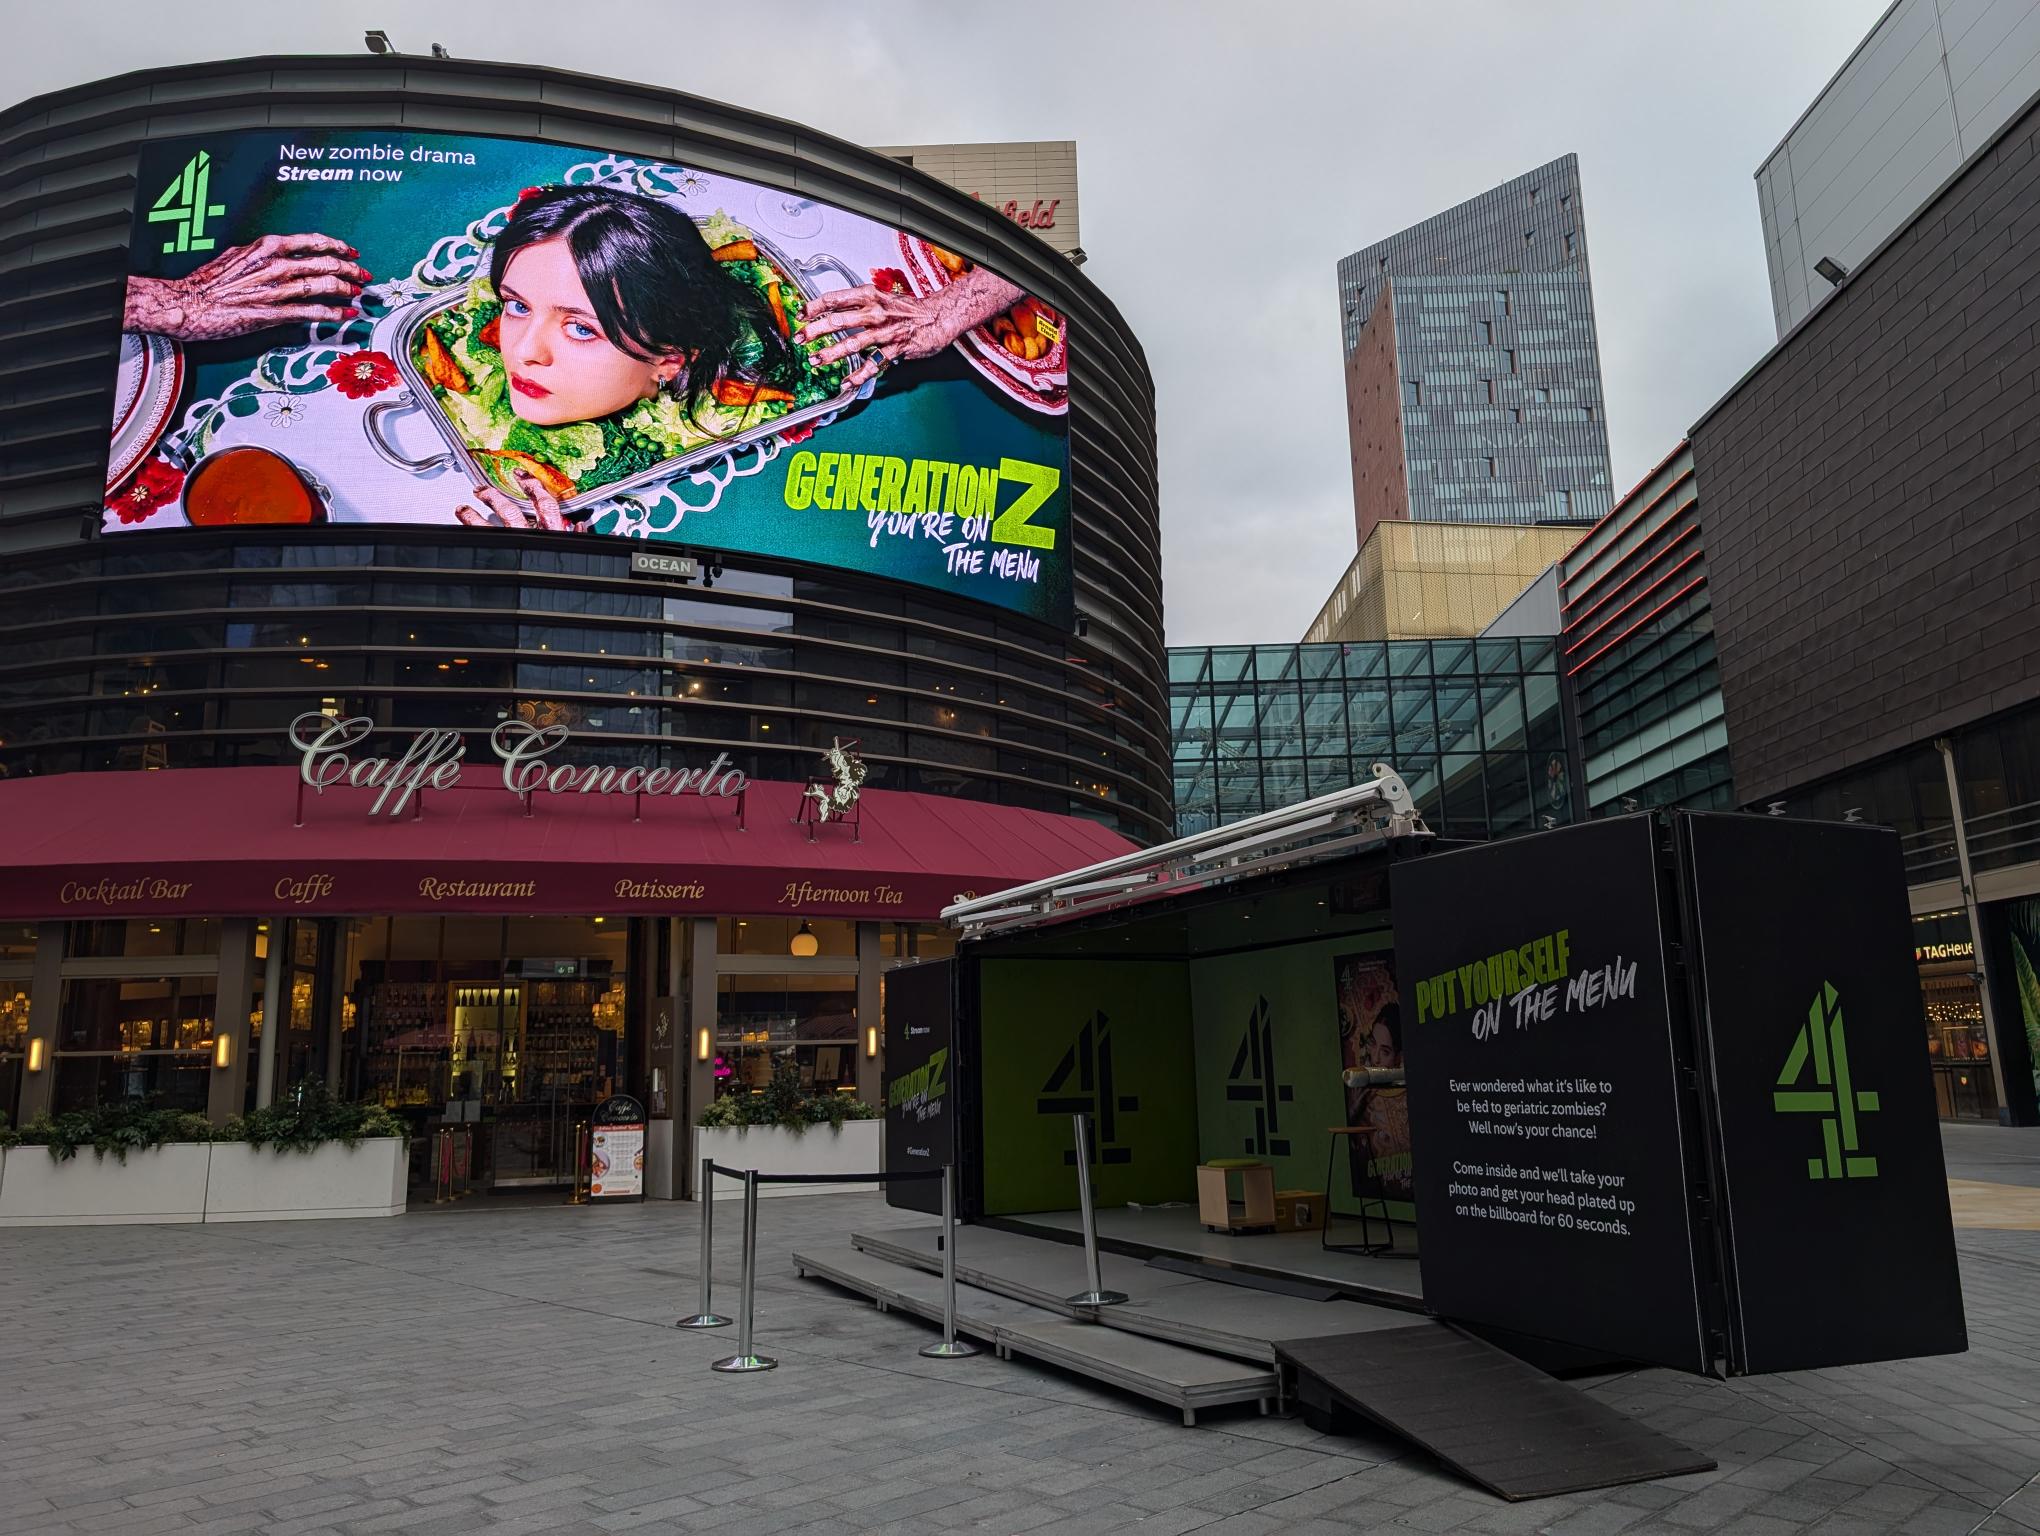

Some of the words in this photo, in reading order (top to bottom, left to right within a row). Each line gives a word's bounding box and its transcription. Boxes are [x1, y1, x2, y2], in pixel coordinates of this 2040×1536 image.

[279, 144, 324, 160] New
[328, 144, 405, 161] zombie
[409, 146, 476, 165] drama
[276, 165, 354, 182] Stream
[358, 168, 402, 182] now
[784, 451, 999, 521] GENERATION
[992, 457, 1061, 550] Z
[867, 509, 955, 548] YOU'RE
[961, 511, 991, 543] ON
[637, 556, 691, 573] OCEAN
[942, 542, 985, 577] THE
[989, 549, 1040, 584] MENU
[491, 720, 751, 801] Concerto
[60, 877, 150, 906] Cocktail
[149, 878, 193, 900] Bar
[419, 876, 536, 901] Restaurant
[614, 878, 705, 900] Patisserie
[778, 880, 870, 907] Afternoon
[874, 883, 904, 905] Tea
[1923, 944, 1947, 960] TAG
[1946, 942, 1974, 957] Heue
[1415, 970, 1457, 1024] PUT
[1457, 929, 1570, 1010] YOURSELF
[1471, 994, 1502, 1042] ON
[1509, 983, 1559, 1031] THE
[1565, 955, 1638, 1014] MENU
[928, 1047, 948, 1100] Z
[1449, 1079, 1470, 1092] Ever
[1472, 1079, 1525, 1093] wondered
[1526, 1079, 1554, 1093] what
[1556, 1079, 1573, 1093] it's
[1575, 1079, 1597, 1093] like
[1598, 1080, 1612, 1094] to
[1457, 1100, 1470, 1112] be
[1471, 1100, 1489, 1113] fed
[1490, 1101, 1502, 1114] to
[1504, 1101, 1550, 1117] geriatric
[1551, 1101, 1607, 1116] zombies?
[1468, 1120, 1492, 1134] Well
[1493, 1122, 1524, 1136] now's
[1525, 1125, 1550, 1140] your
[1551, 1123, 1598, 1139] chance!
[1453, 1161, 1484, 1175] Come
[1485, 1162, 1518, 1178] inside
[1519, 1166, 1540, 1180] and
[1541, 1168, 1568, 1182] we'll
[1569, 1170, 1596, 1184] take
[1597, 1174, 1625, 1189] your
[1448, 1181, 1479, 1197] photo
[1480, 1185, 1500, 1198] and
[1501, 1187, 1519, 1202] get
[1519, 1190, 1545, 1204] your
[1546, 1190, 1575, 1206] head
[1577, 1193, 1617, 1210] plated
[1618, 1199, 1636, 1215] up
[1455, 1204, 1469, 1216] on
[1470, 1204, 1487, 1218] the
[1489, 1205, 1537, 1224] billboard
[1539, 1211, 1556, 1226] for
[1557, 1213, 1574, 1228] 60
[1576, 1219, 1631, 1236] seconds.
